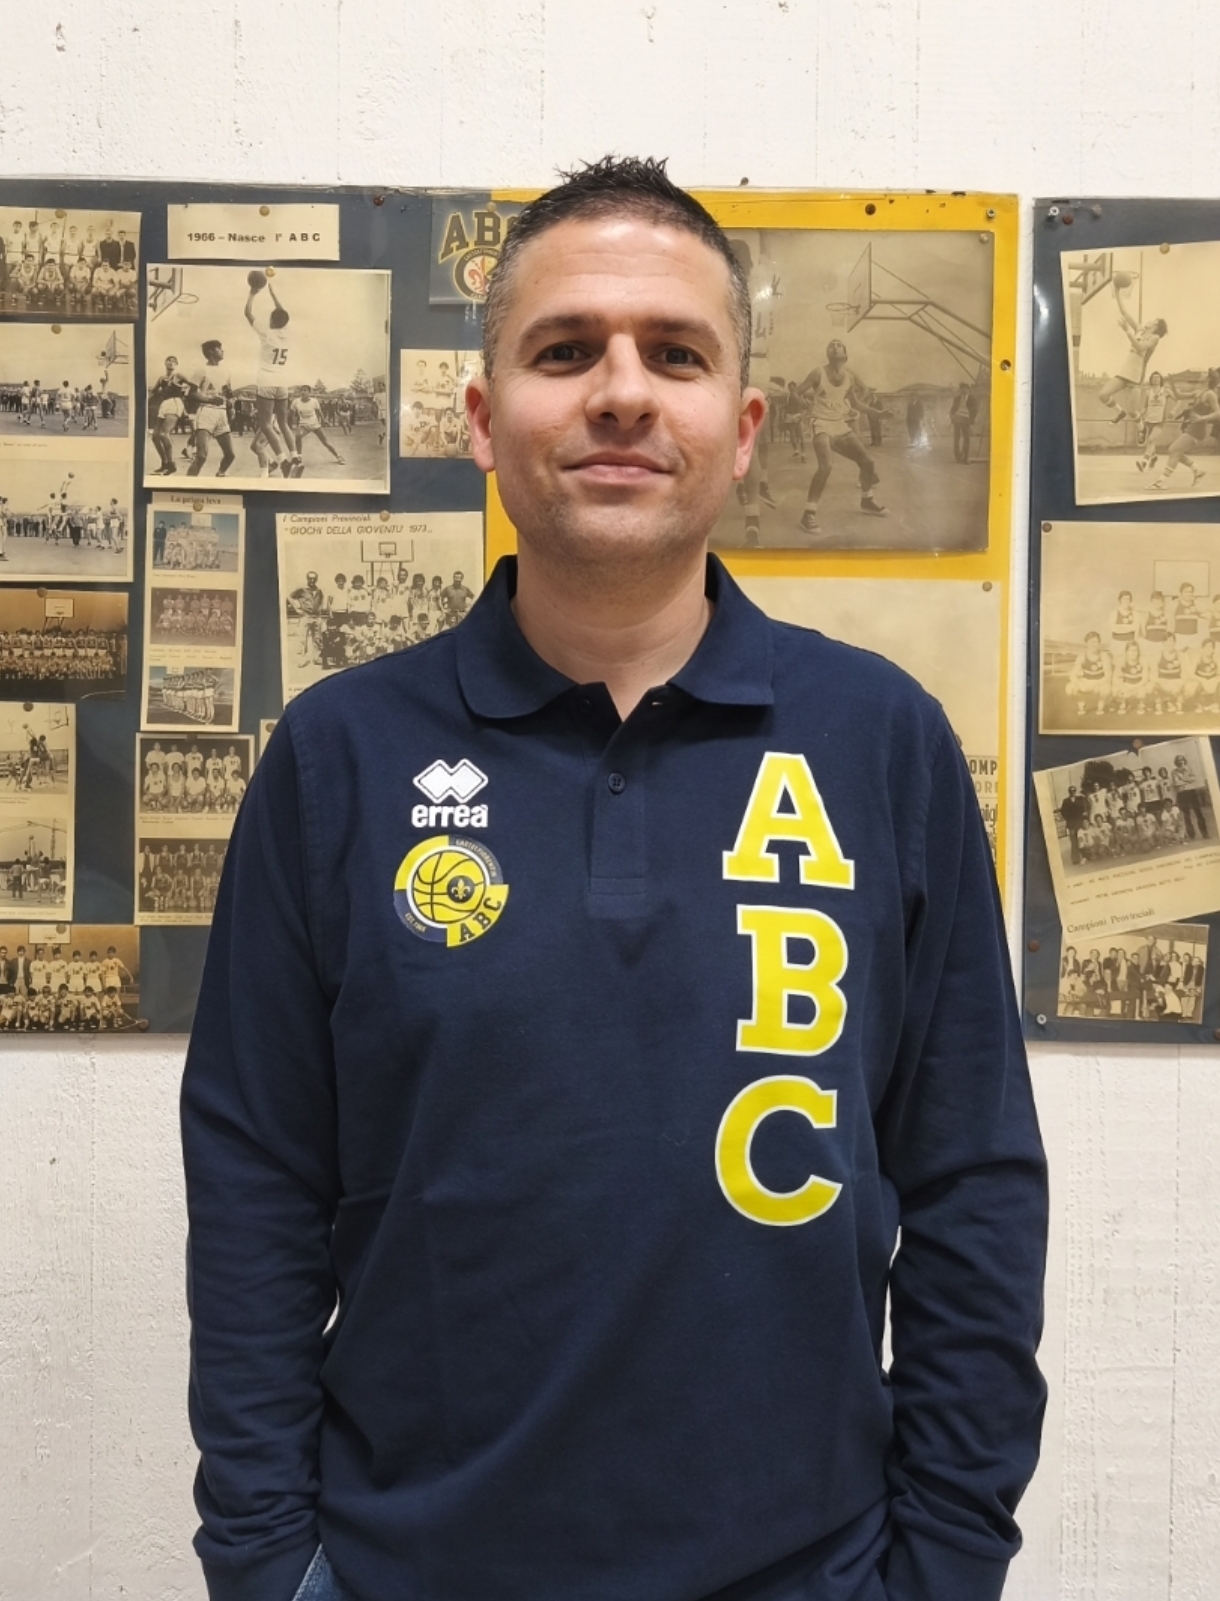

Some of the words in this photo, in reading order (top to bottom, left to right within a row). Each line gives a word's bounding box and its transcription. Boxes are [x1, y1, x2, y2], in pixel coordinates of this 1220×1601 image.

[187, 232, 215, 242] 1966
[228, 232, 265, 243] Nasce
[289, 232, 298, 242] A
[301, 232, 309, 242] B
[312, 232, 321, 242] C
[272, 348, 289, 366] 15
[170, 494, 181, 503] La
[206, 496, 221, 505] leva
[290, 514, 328, 525] Campioni
[331, 513, 372, 523] Provinciali
[326, 525, 352, 535] DELLA
[458, 897, 503, 943] ABC
[1066, 918, 1107, 934] Campioni
[1110, 908, 1155, 926] Provinciali
